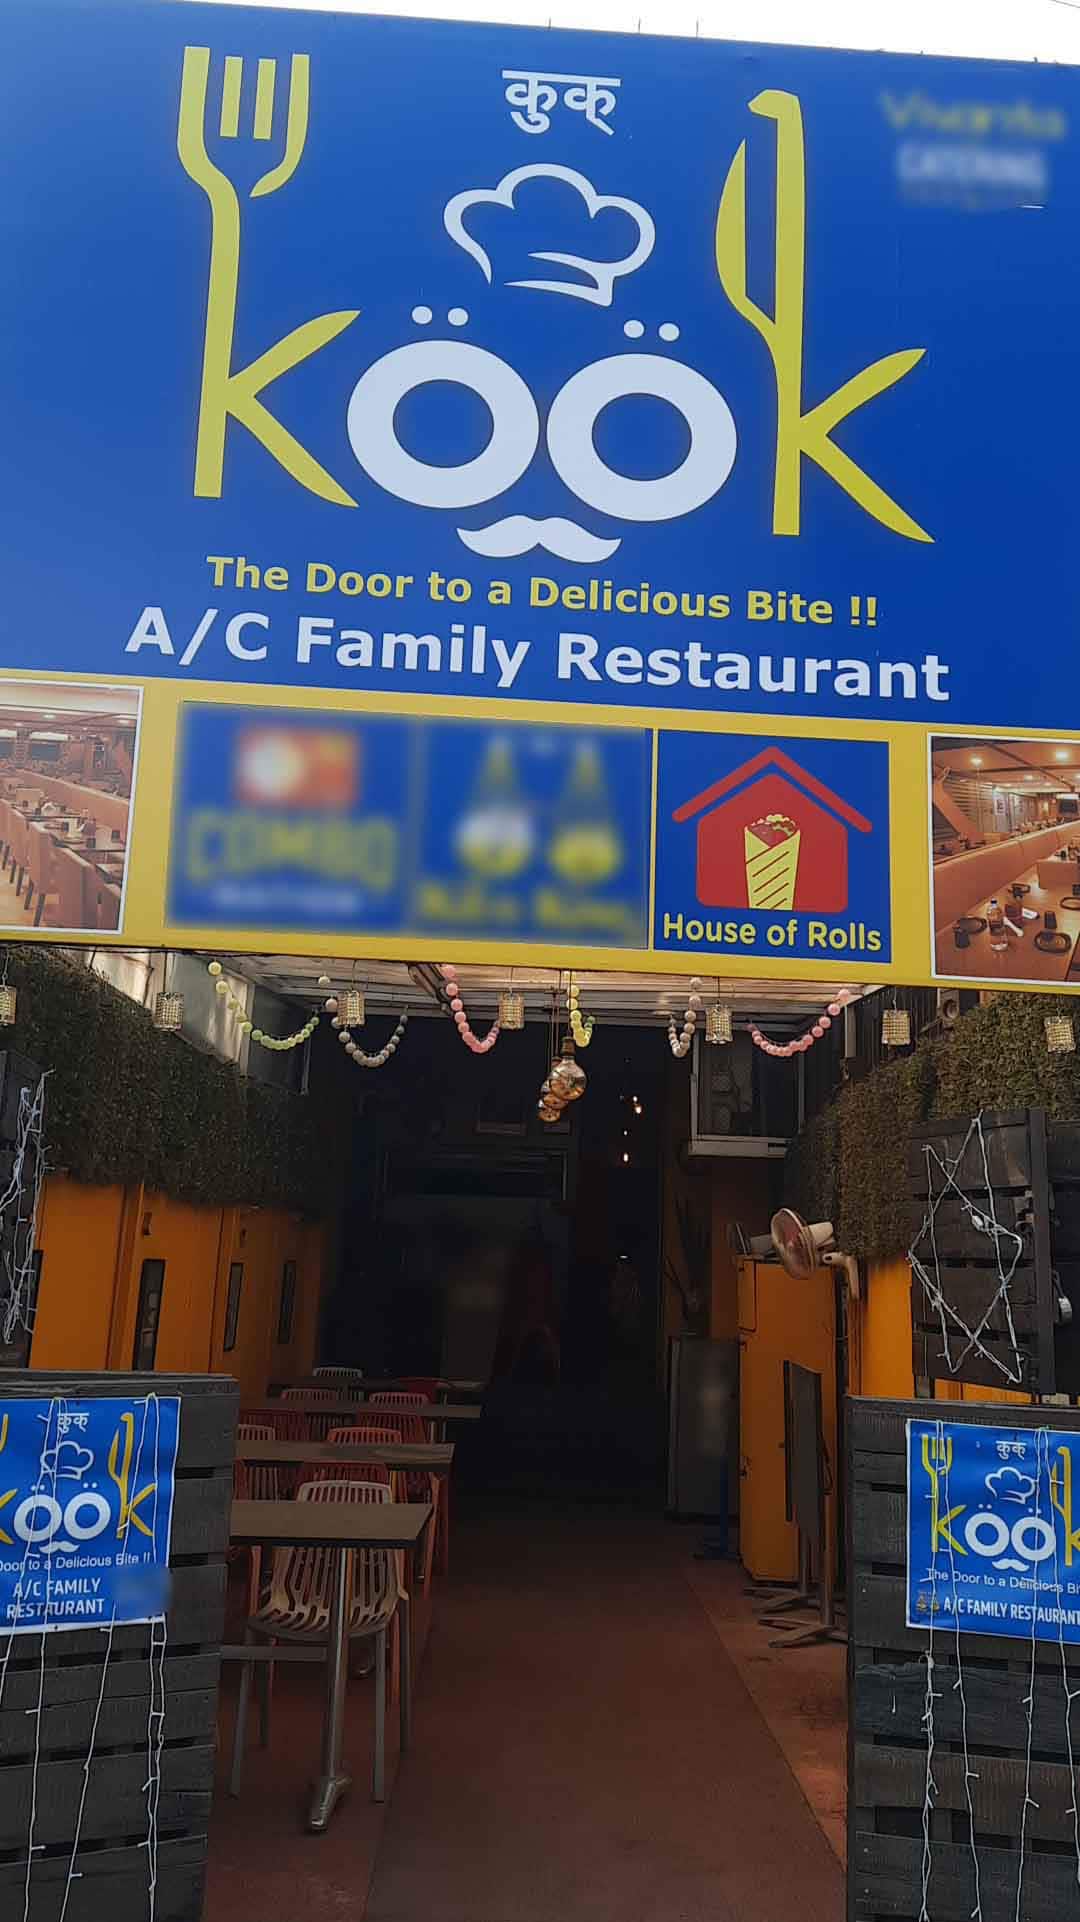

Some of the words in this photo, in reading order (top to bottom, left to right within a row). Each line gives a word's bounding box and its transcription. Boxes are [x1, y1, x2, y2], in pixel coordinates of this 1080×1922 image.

[502, 70, 621, 135] कुक्
[206, 556, 289, 591] The
[306, 563, 414, 598] Door
[428, 571, 472, 602] to
[487, 581, 511, 605] a
[530, 577, 730, 619] Delicious
[747, 590, 834, 625] Bite
[850, 596, 877, 627] !!
[125, 606, 270, 666] A/C
[296, 616, 531, 688] Family
[557, 632, 950, 701] Restaurant
[663, 912, 756, 945] House
[766, 919, 798, 947] of
[807, 920, 882, 952] Rolls
[29, 1560, 40, 1571] to
[55, 1555, 112, 1569] Delicious
[115, 1552, 139, 1566] Bite
[13, 1579, 42, 1600] A/C
[47, 1576, 101, 1596] FAMILY
[926, 1568, 949, 1581] The
[952, 1570, 981, 1585] Door
[984, 1574, 995, 1586] to
[999, 1577, 1006, 1587] a
[1009, 1576, 1064, 1593] Delicious
[6, 1598, 105, 1619] RESTAURANT
[944, 1596, 965, 1615] A/C
[967, 1599, 1008, 1618] FAMILY
